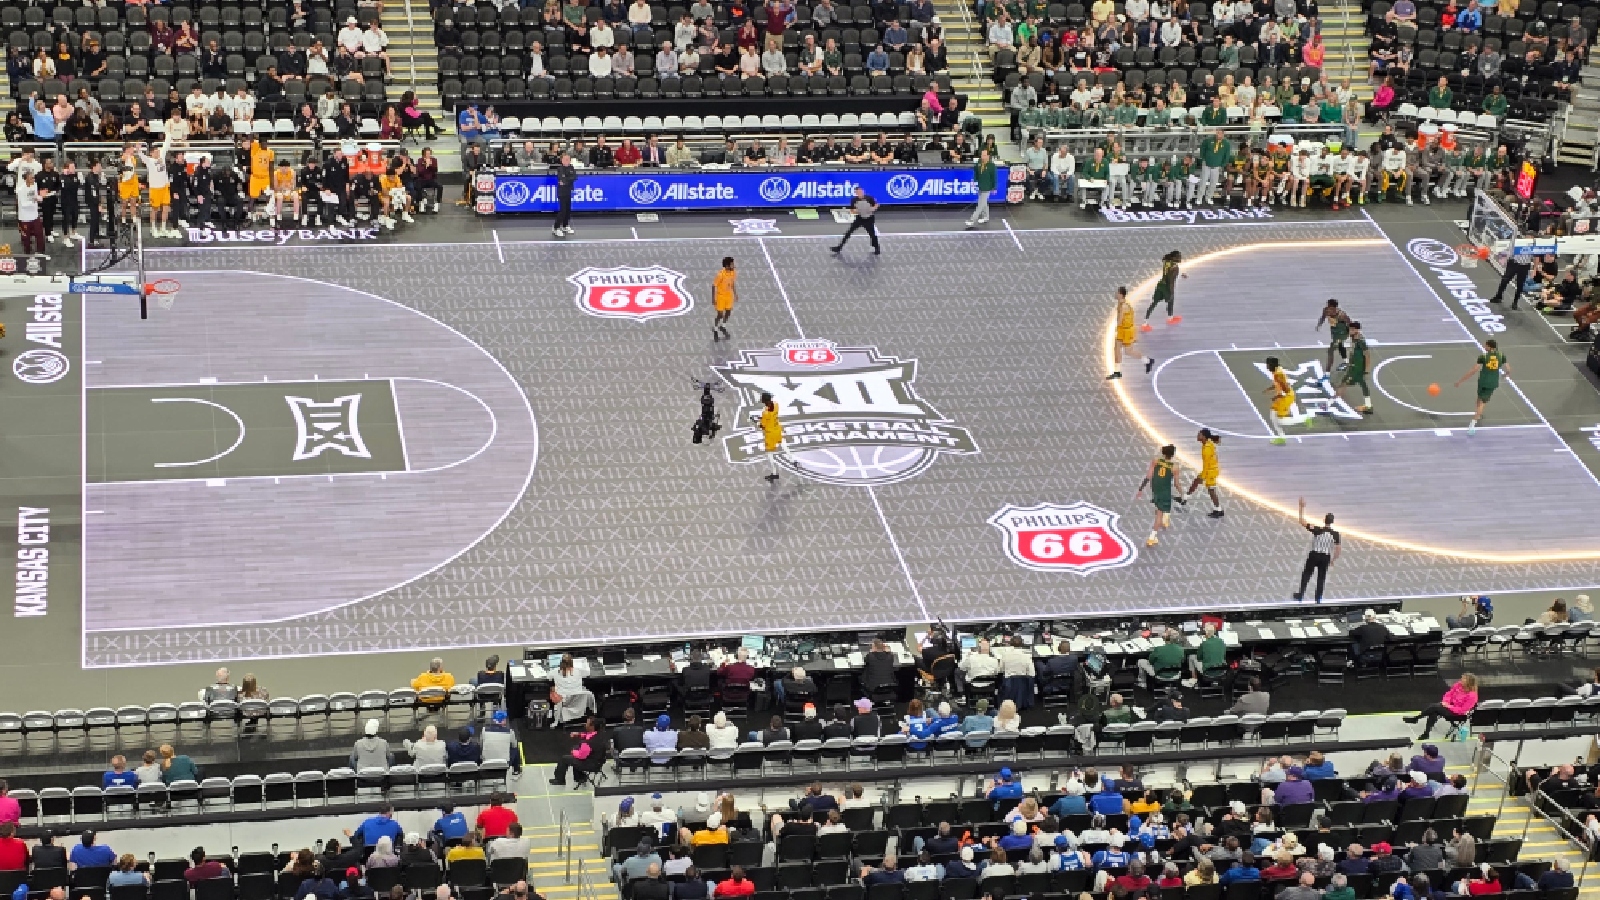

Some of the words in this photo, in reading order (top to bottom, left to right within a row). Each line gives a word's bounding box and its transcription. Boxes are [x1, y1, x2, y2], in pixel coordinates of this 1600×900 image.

[662, 182, 735, 200] Allstate
[298, 227, 379, 240] BANK
[588, 273, 668, 285] PHILLIPS
[600, 288, 667, 308] 66
[1430, 267, 1506, 333] Allstate
[793, 350, 828, 361] 66
[730, 366, 929, 416] XII
[18, 506, 50, 545] CITY
[1010, 513, 1100, 528] PHILLIPS
[1030, 531, 1103, 558] 66
[14, 548, 49, 617] KANSAS
